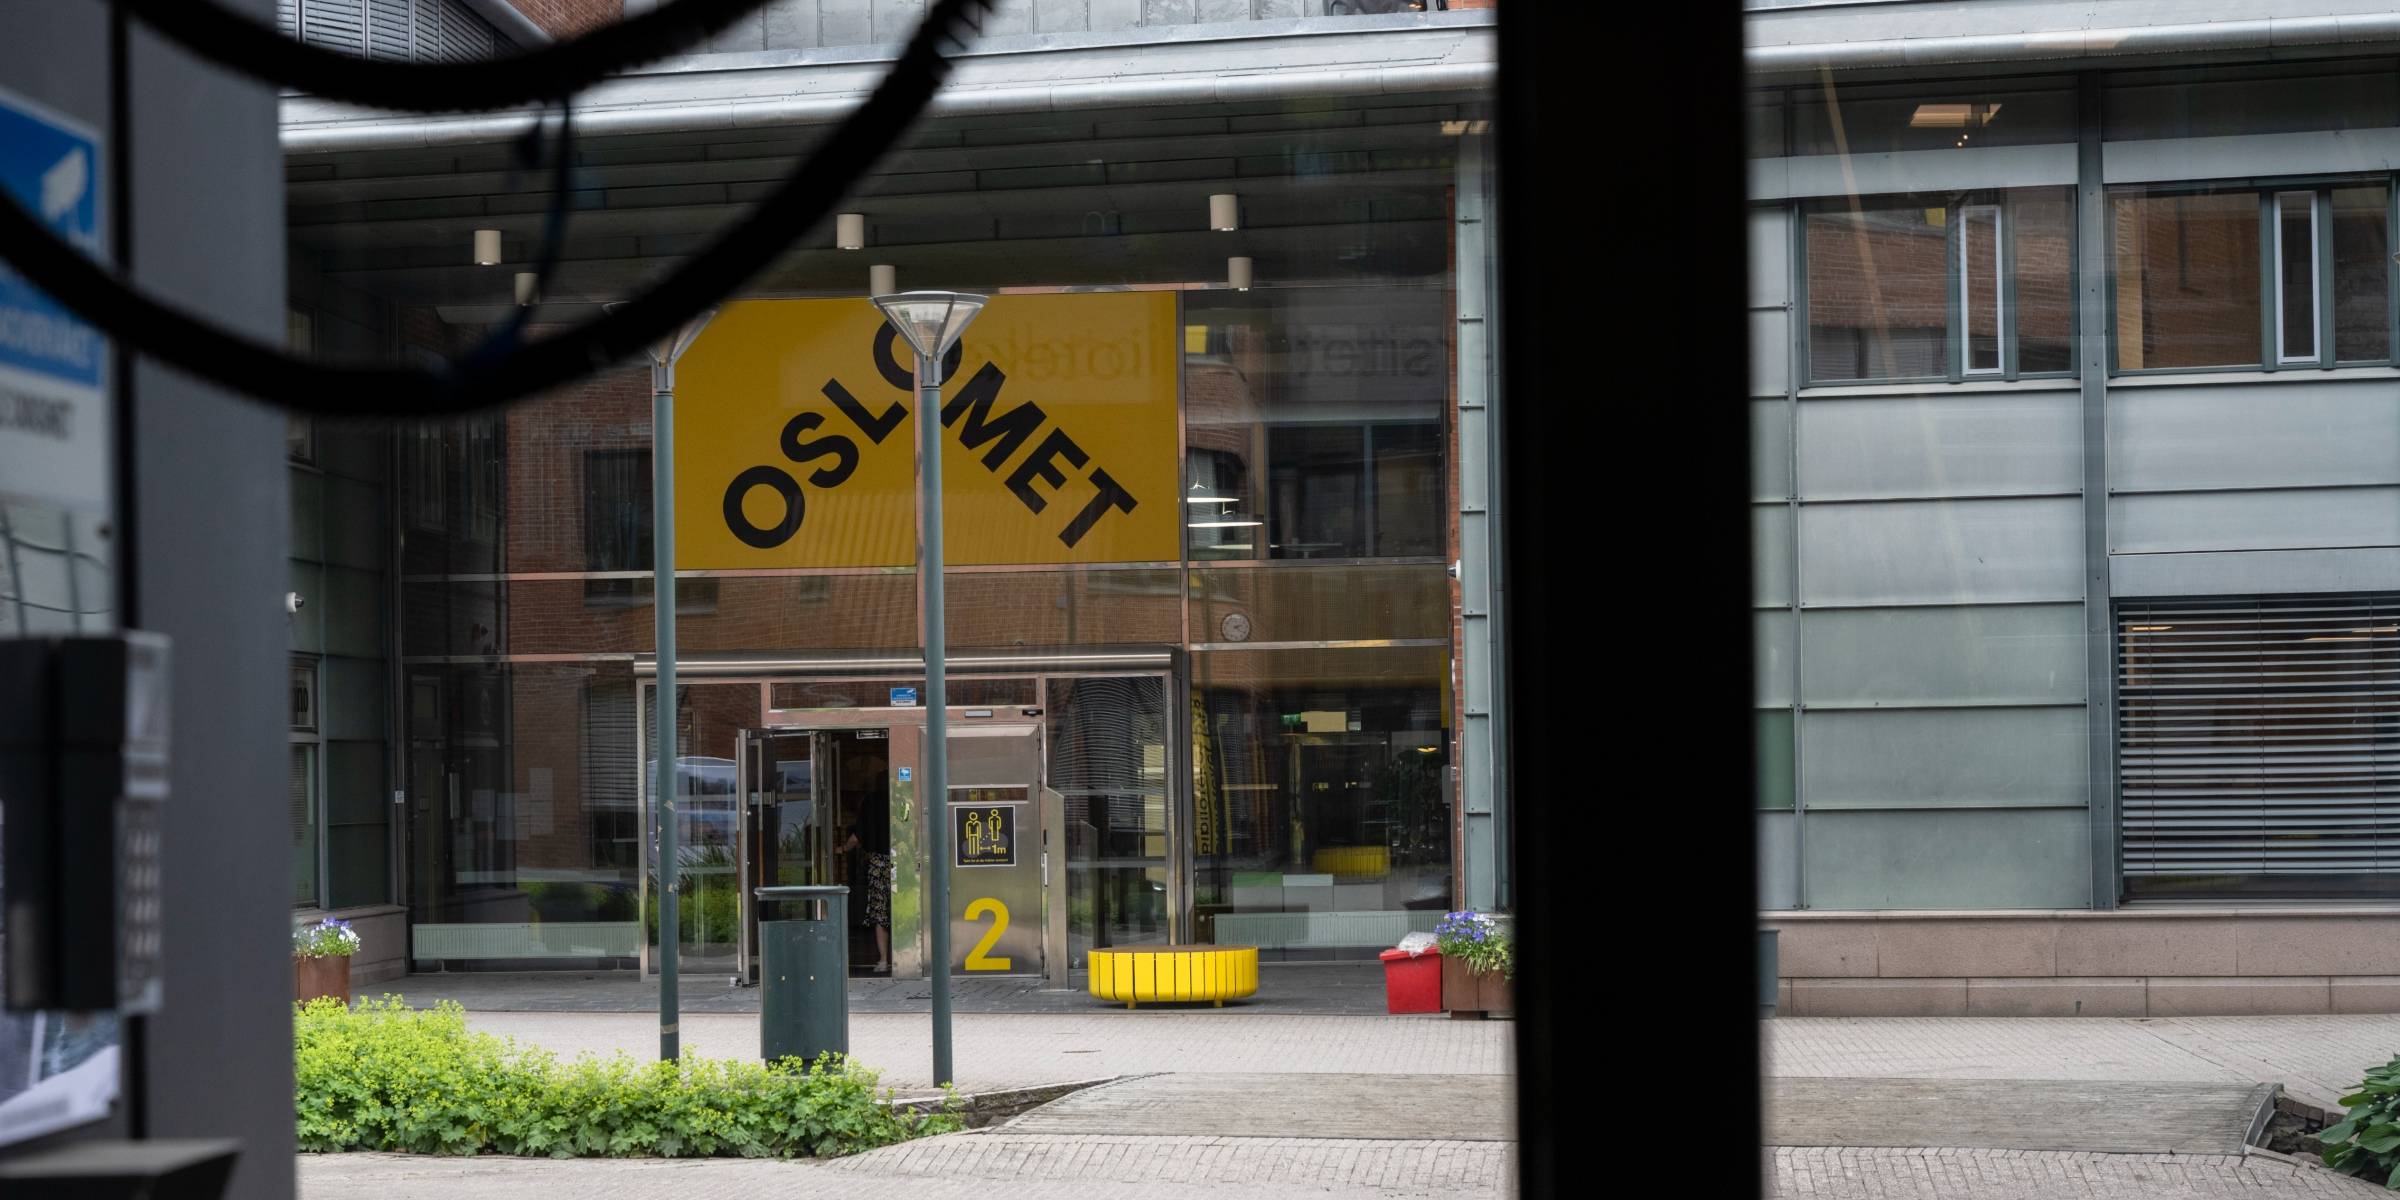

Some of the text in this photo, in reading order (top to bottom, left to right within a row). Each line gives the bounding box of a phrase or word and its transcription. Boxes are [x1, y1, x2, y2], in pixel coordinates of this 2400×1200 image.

[723, 318, 1138, 549] OSLOMET
[992, 844, 1007, 854] 1m
[964, 897, 1011, 971] 2
